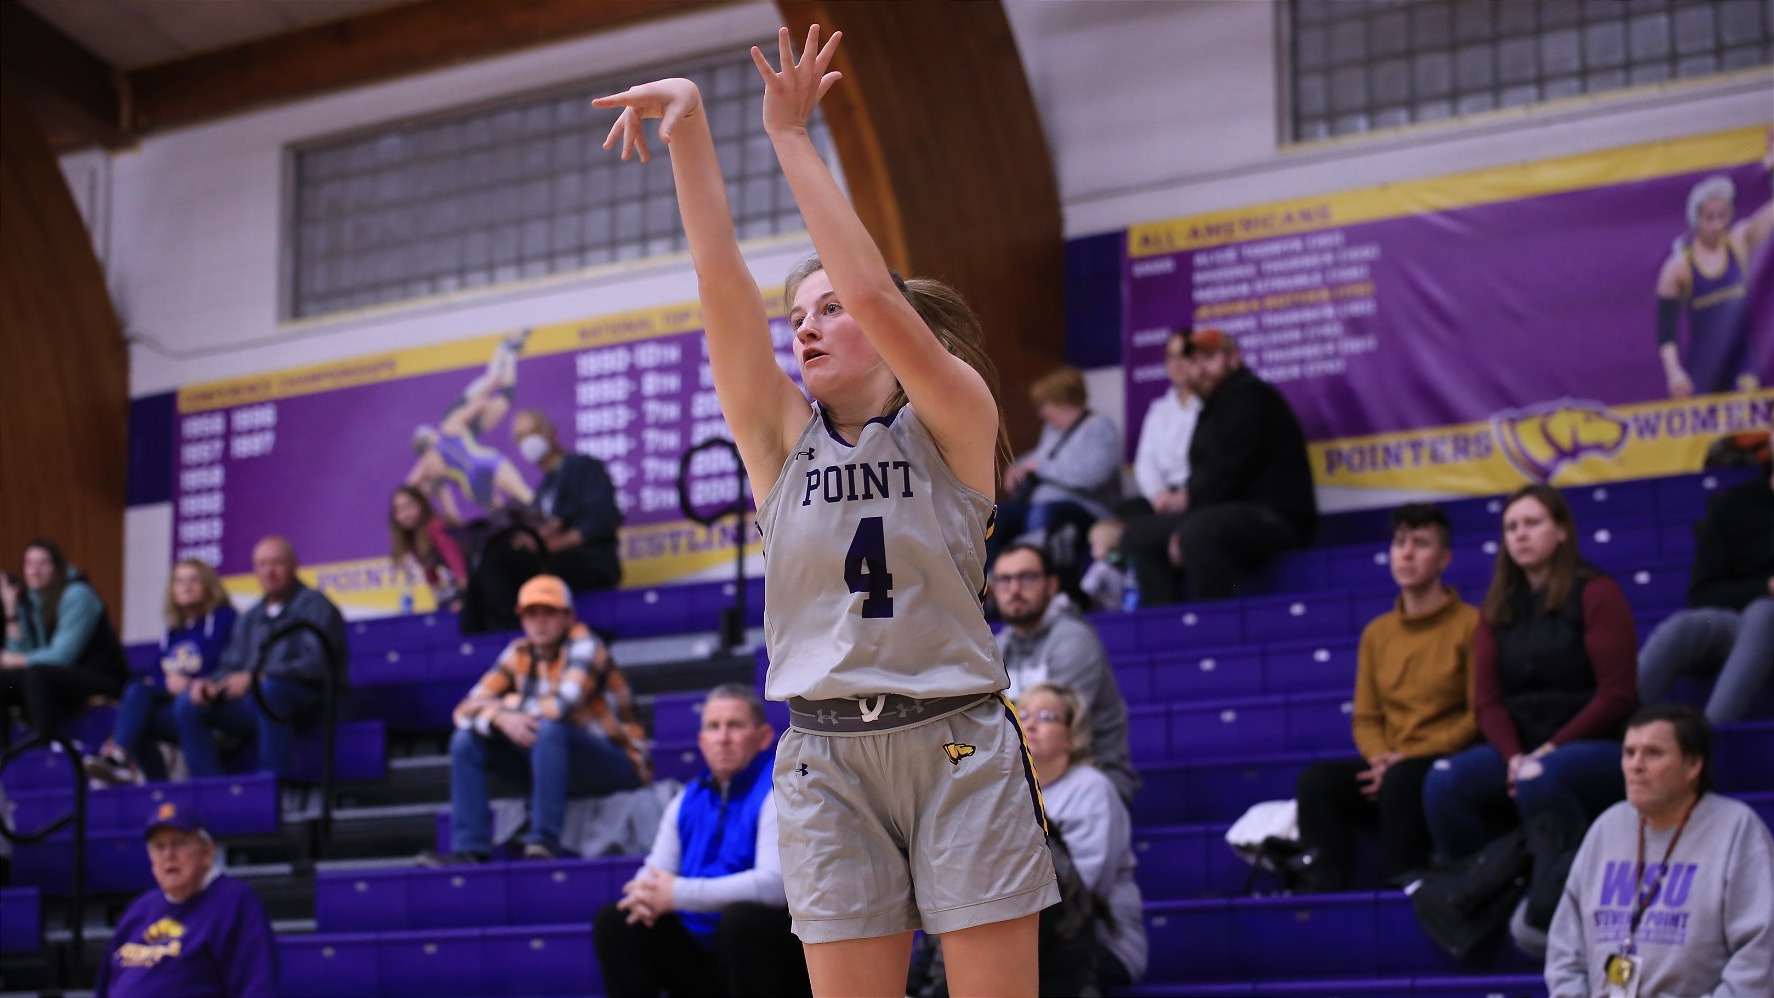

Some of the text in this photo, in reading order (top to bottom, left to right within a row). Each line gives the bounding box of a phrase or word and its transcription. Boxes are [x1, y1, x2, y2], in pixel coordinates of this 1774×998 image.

[1324, 430, 1494, 476] POINTERS
[802, 461, 914, 506] POINT
[844, 516, 893, 618] 4
[1599, 860, 1698, 907] WSU
